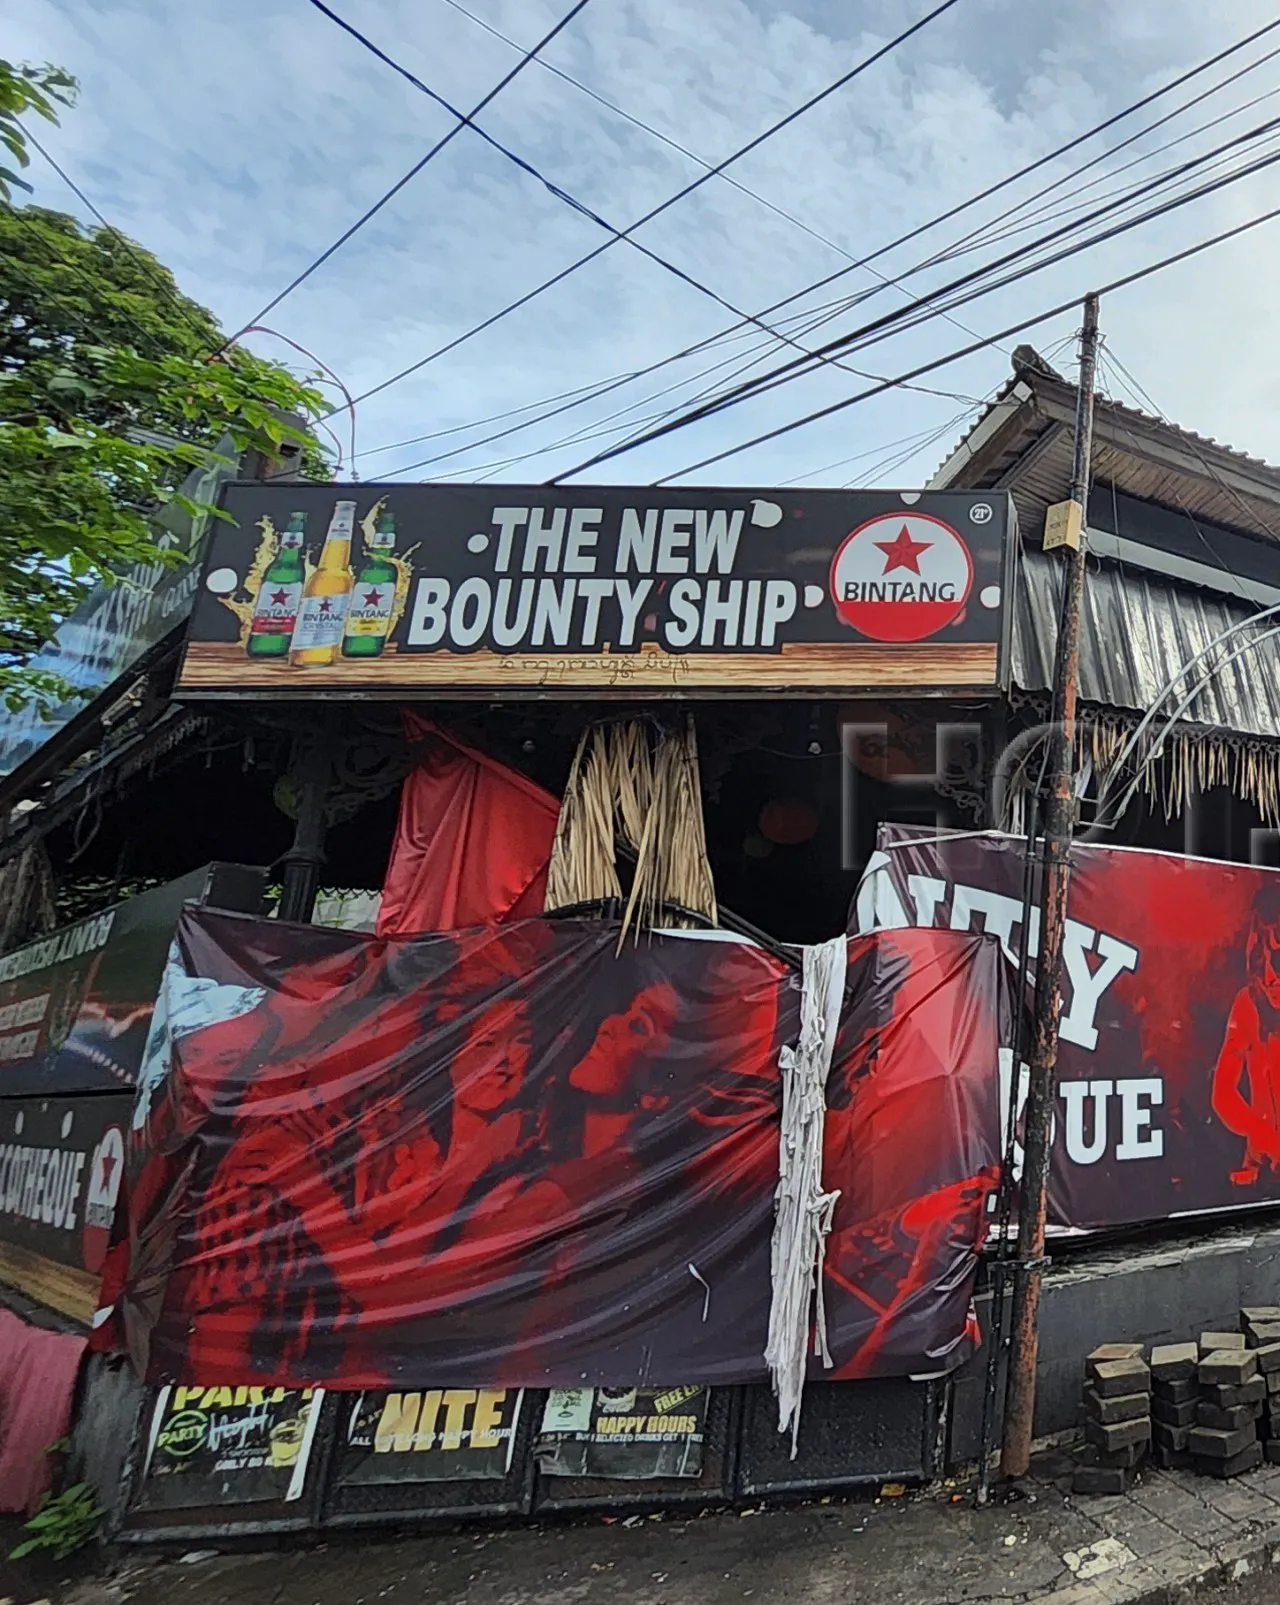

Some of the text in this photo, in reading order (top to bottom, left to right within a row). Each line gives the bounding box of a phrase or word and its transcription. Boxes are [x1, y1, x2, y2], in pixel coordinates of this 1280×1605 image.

[490, 507, 746, 574] THE NEW
[844, 581, 957, 603] BINTANG
[407, 578, 799, 648] BOUNTY SHIP
[653, 1390, 684, 1413] FREE
[375, 1389, 506, 1453] NITE
[596, 1415, 697, 1434] HAPPY HOURS
[157, 1423, 208, 1448] PARTY
